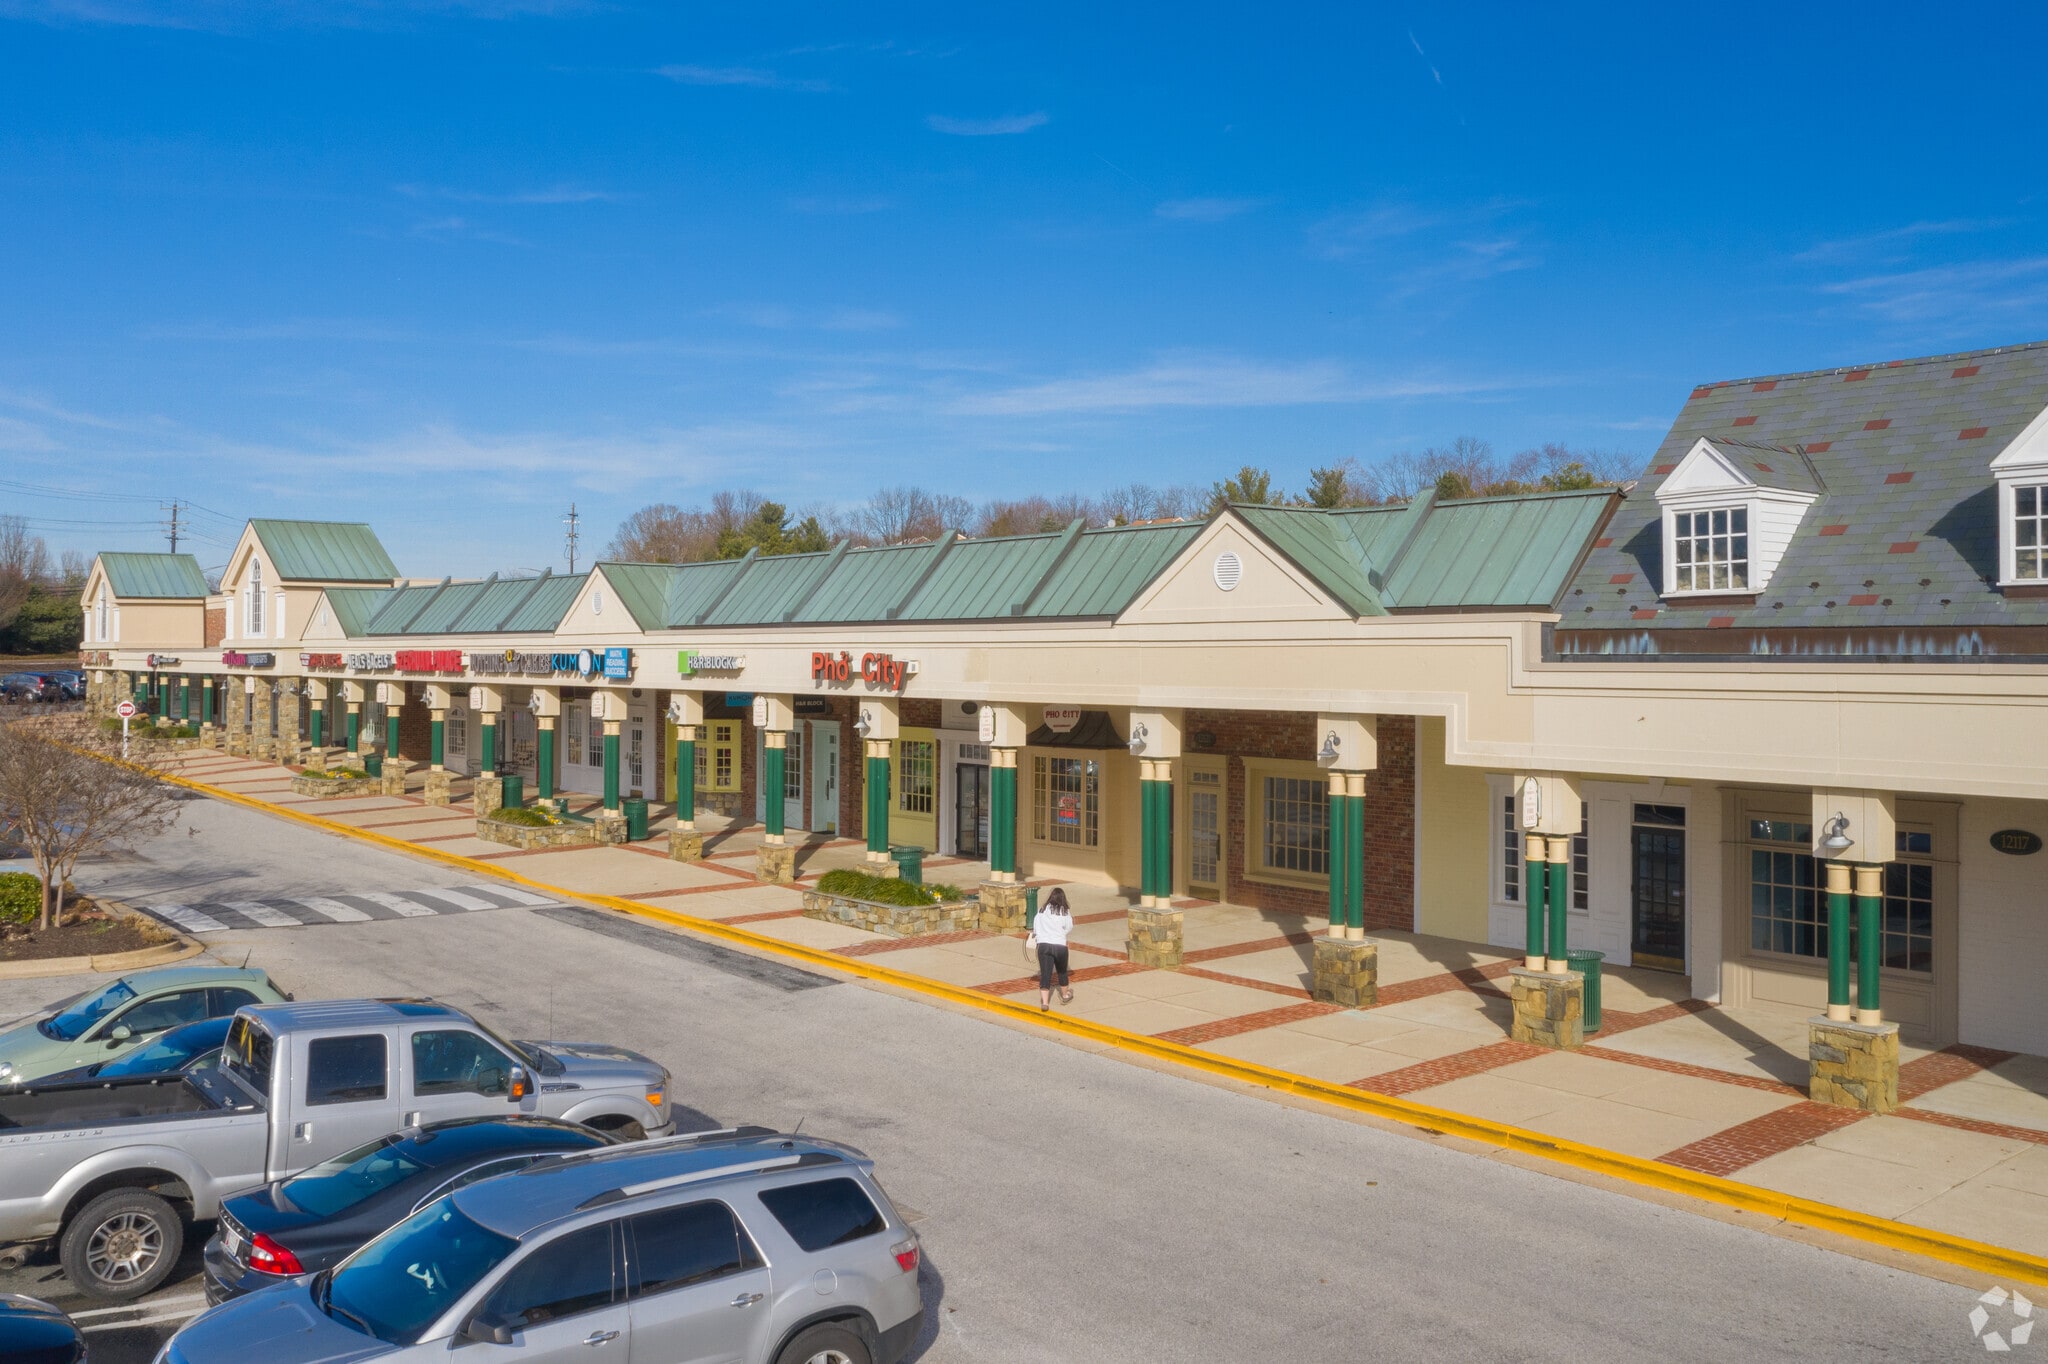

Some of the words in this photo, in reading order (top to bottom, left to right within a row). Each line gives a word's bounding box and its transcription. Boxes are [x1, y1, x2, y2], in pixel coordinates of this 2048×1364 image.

[552, 649, 601, 675] KUMON
[688, 657, 704, 669] H&R
[706, 657, 733, 669] BLOCK
[861, 652, 904, 691] City
[120, 706, 133, 714] STOP
[1045, 710, 1060, 718] PHO
[1062, 710, 1079, 718] CITY
[0, 1129, 103, 1144] LATINUM
